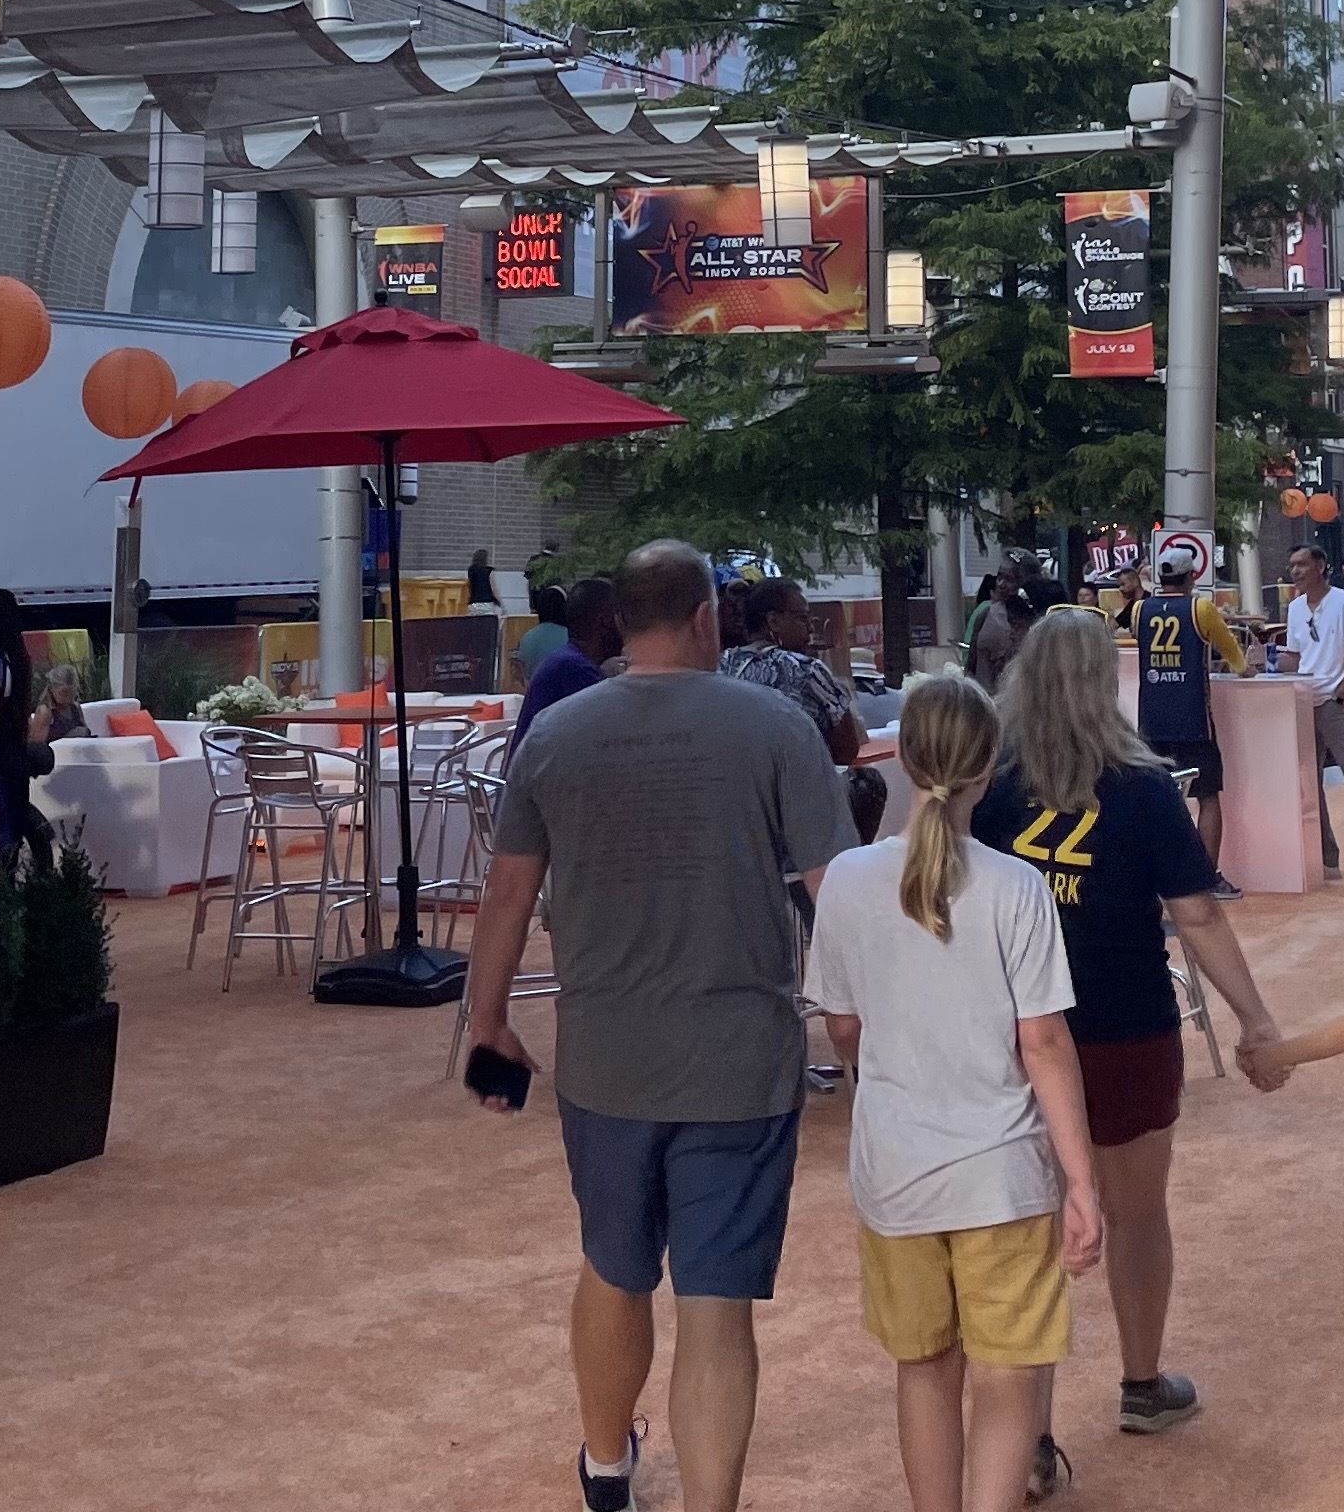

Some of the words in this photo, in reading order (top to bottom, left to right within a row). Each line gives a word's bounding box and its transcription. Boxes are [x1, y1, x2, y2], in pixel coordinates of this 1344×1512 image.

[498, 213, 562, 236] UNCH
[719, 238, 744, 248] AT&T
[498, 239, 562, 263] BOWL
[1085, 252, 1145, 262] CHALLENGE
[690, 252, 734, 267] ALL
[743, 249, 802, 264] STAR
[389, 262, 438, 273] WNBA
[705, 267, 741, 278] INDY
[749, 266, 787, 276] 2025
[388, 273, 426, 285] LIVE
[497, 265, 561, 289] SOCIAL
[1088, 302, 1137, 312] CONTEST
[1086, 345, 1117, 354] JULY
[1119, 344, 1136, 353] 18
[1149, 615, 1181, 652] 22
[1149, 653, 1181, 667] CLARK
[1159, 671, 1187, 683] AT&T
